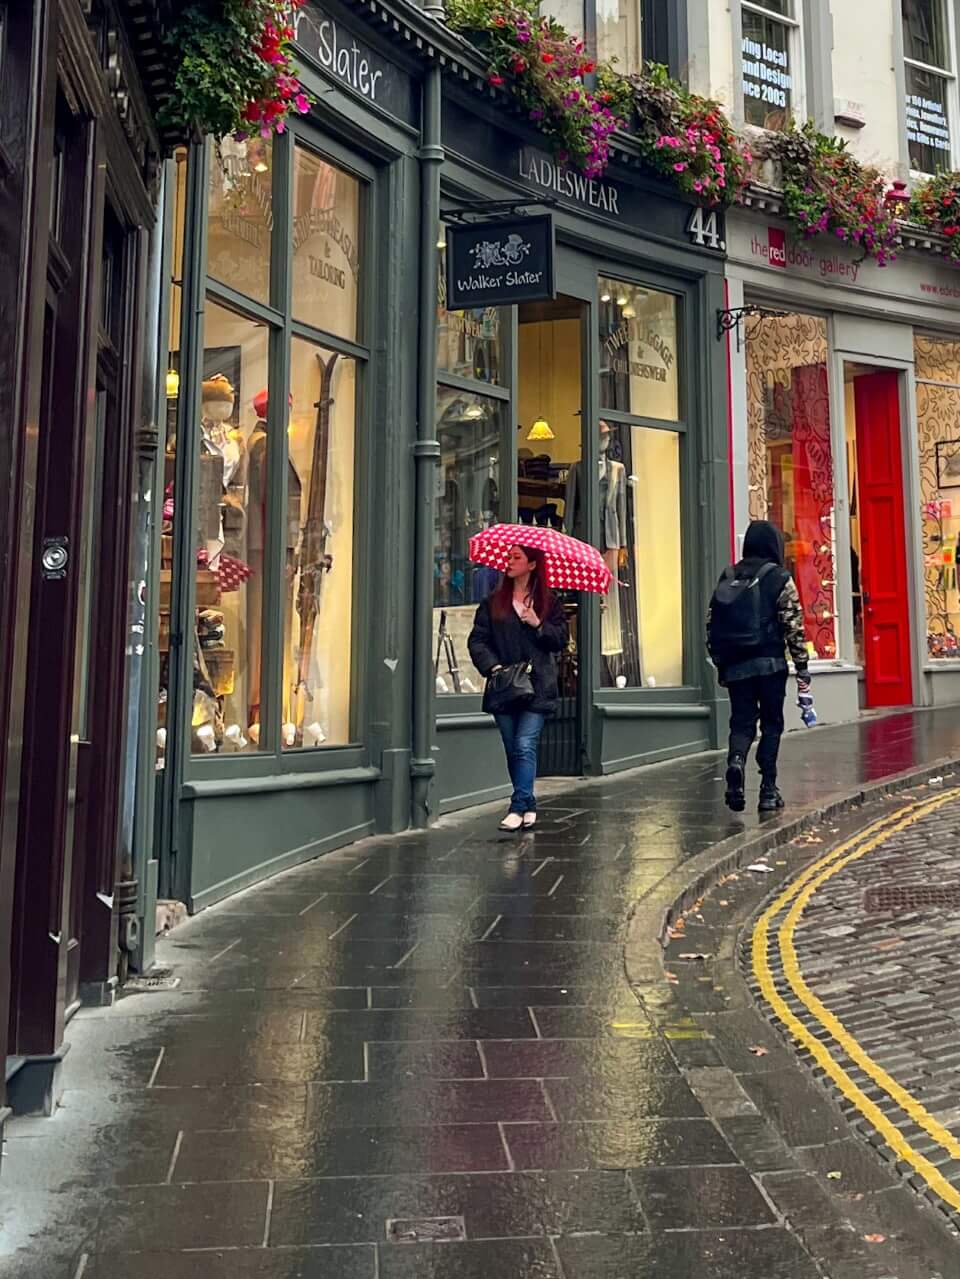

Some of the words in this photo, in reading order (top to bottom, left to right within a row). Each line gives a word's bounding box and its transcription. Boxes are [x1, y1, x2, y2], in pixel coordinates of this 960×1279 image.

[319, 21, 382, 99] Slater
[762, 43, 787, 67] Local
[761, 84, 786, 108] 2003
[519, 149, 619, 214] LADIESWEAR
[309, 255, 345, 289] TAILORING
[751, 231, 767, 257] the
[769, 241, 785, 261] red
[787, 241, 815, 267] door
[820, 256, 859, 281] gallery
[457, 275, 503, 291] Walker
[506, 271, 542, 286] Slater
